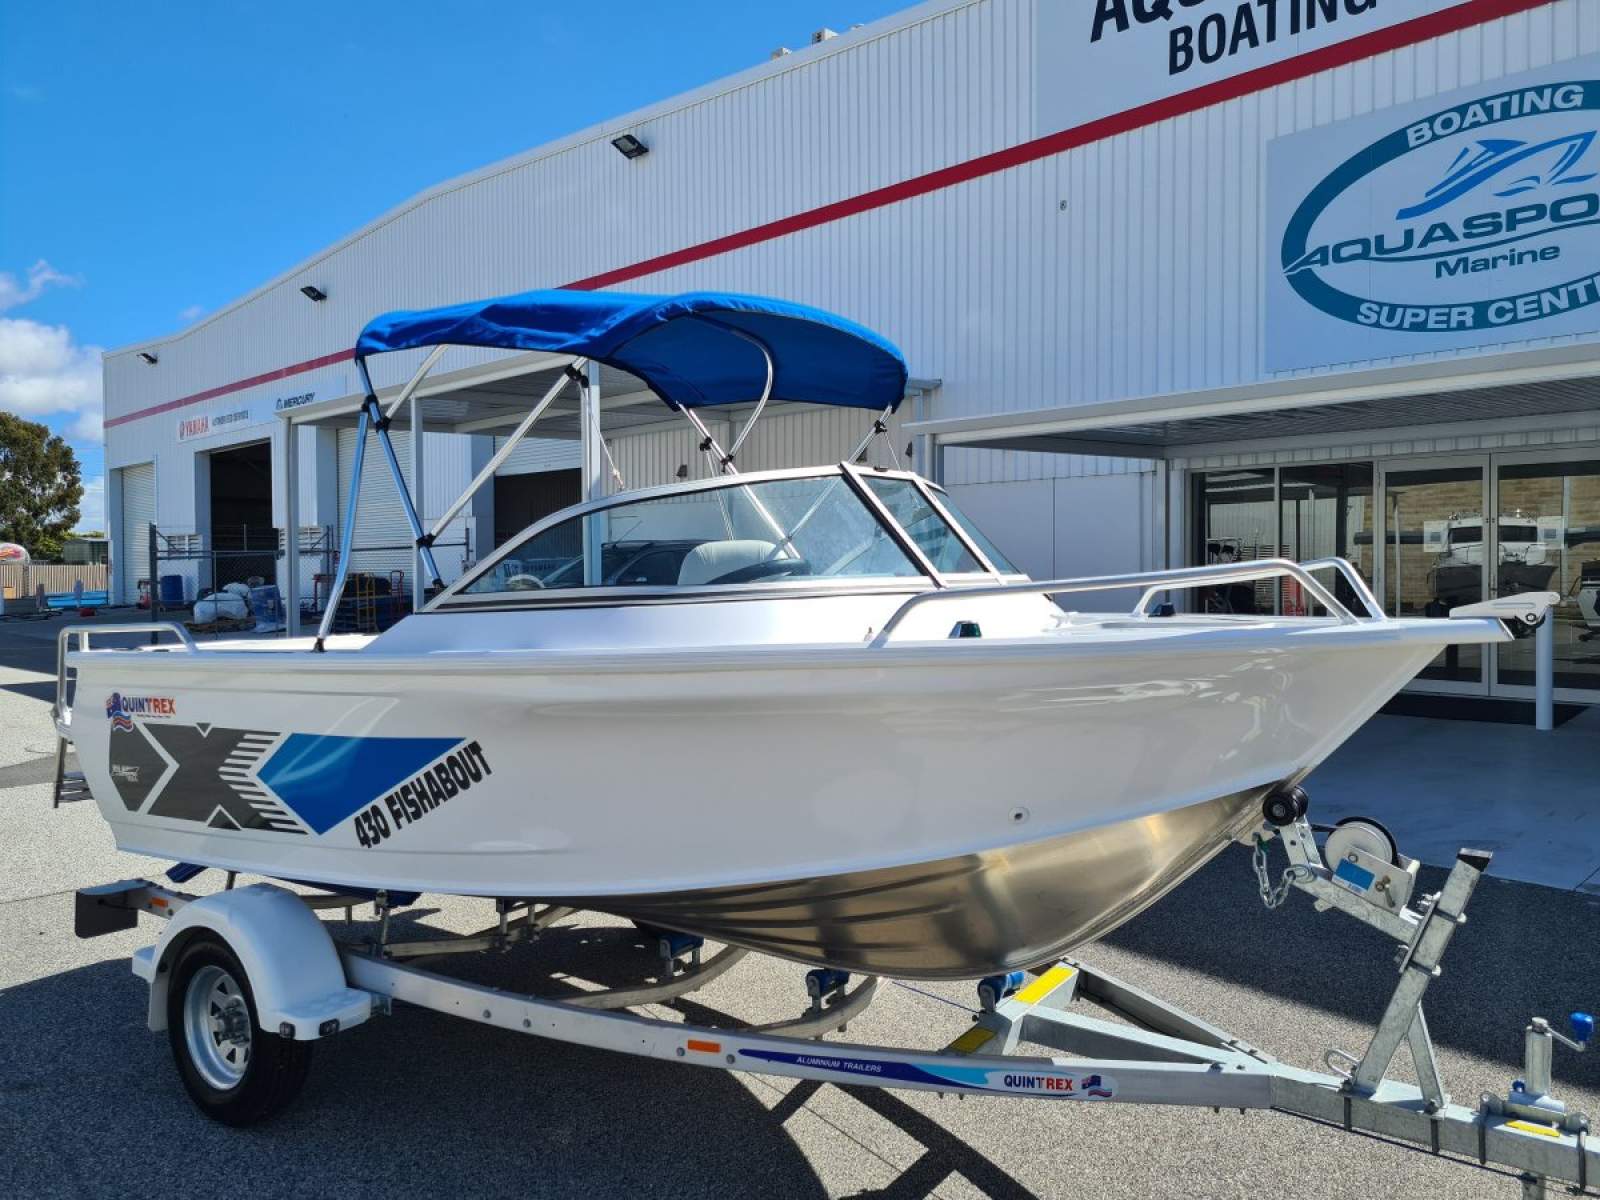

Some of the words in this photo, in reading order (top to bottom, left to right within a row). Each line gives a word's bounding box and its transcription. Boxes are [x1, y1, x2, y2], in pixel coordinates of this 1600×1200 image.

[1406, 84, 1585, 149] BOATING
[1435, 245, 1561, 279] Marine
[1356, 302, 1475, 329] SUPER
[122, 696, 176, 714] QUINTREX
[353, 804, 391, 849] 430
[384, 740, 492, 831] FISHABOUT
[796, 1056, 841, 1068] ALUMINIUM
[843, 1062, 882, 1073] TRAILERS
[1003, 1074, 1073, 1091] QUINTREX
